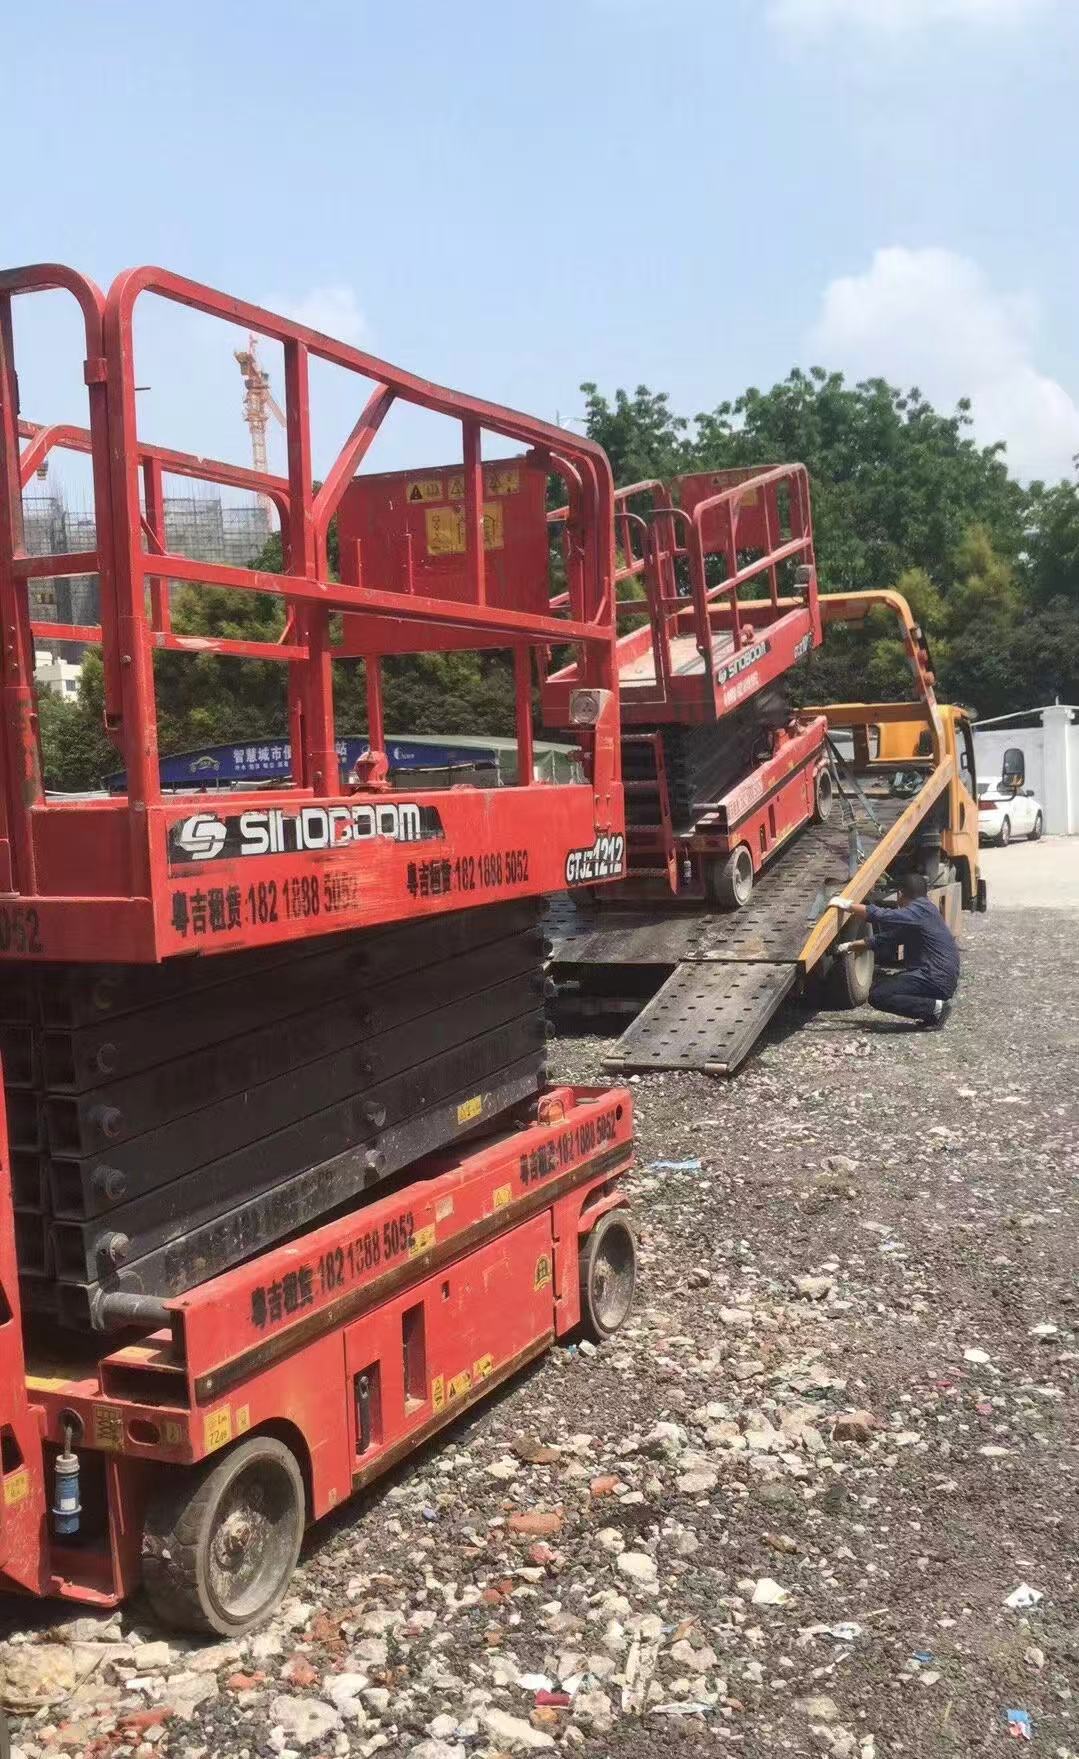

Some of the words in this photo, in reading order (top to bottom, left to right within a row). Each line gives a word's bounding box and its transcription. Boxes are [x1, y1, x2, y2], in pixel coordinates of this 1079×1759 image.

[505, 850, 529, 883] 5052
[566, 836, 623, 882] GTJZ1212
[383, 1211, 417, 1261] 5052
